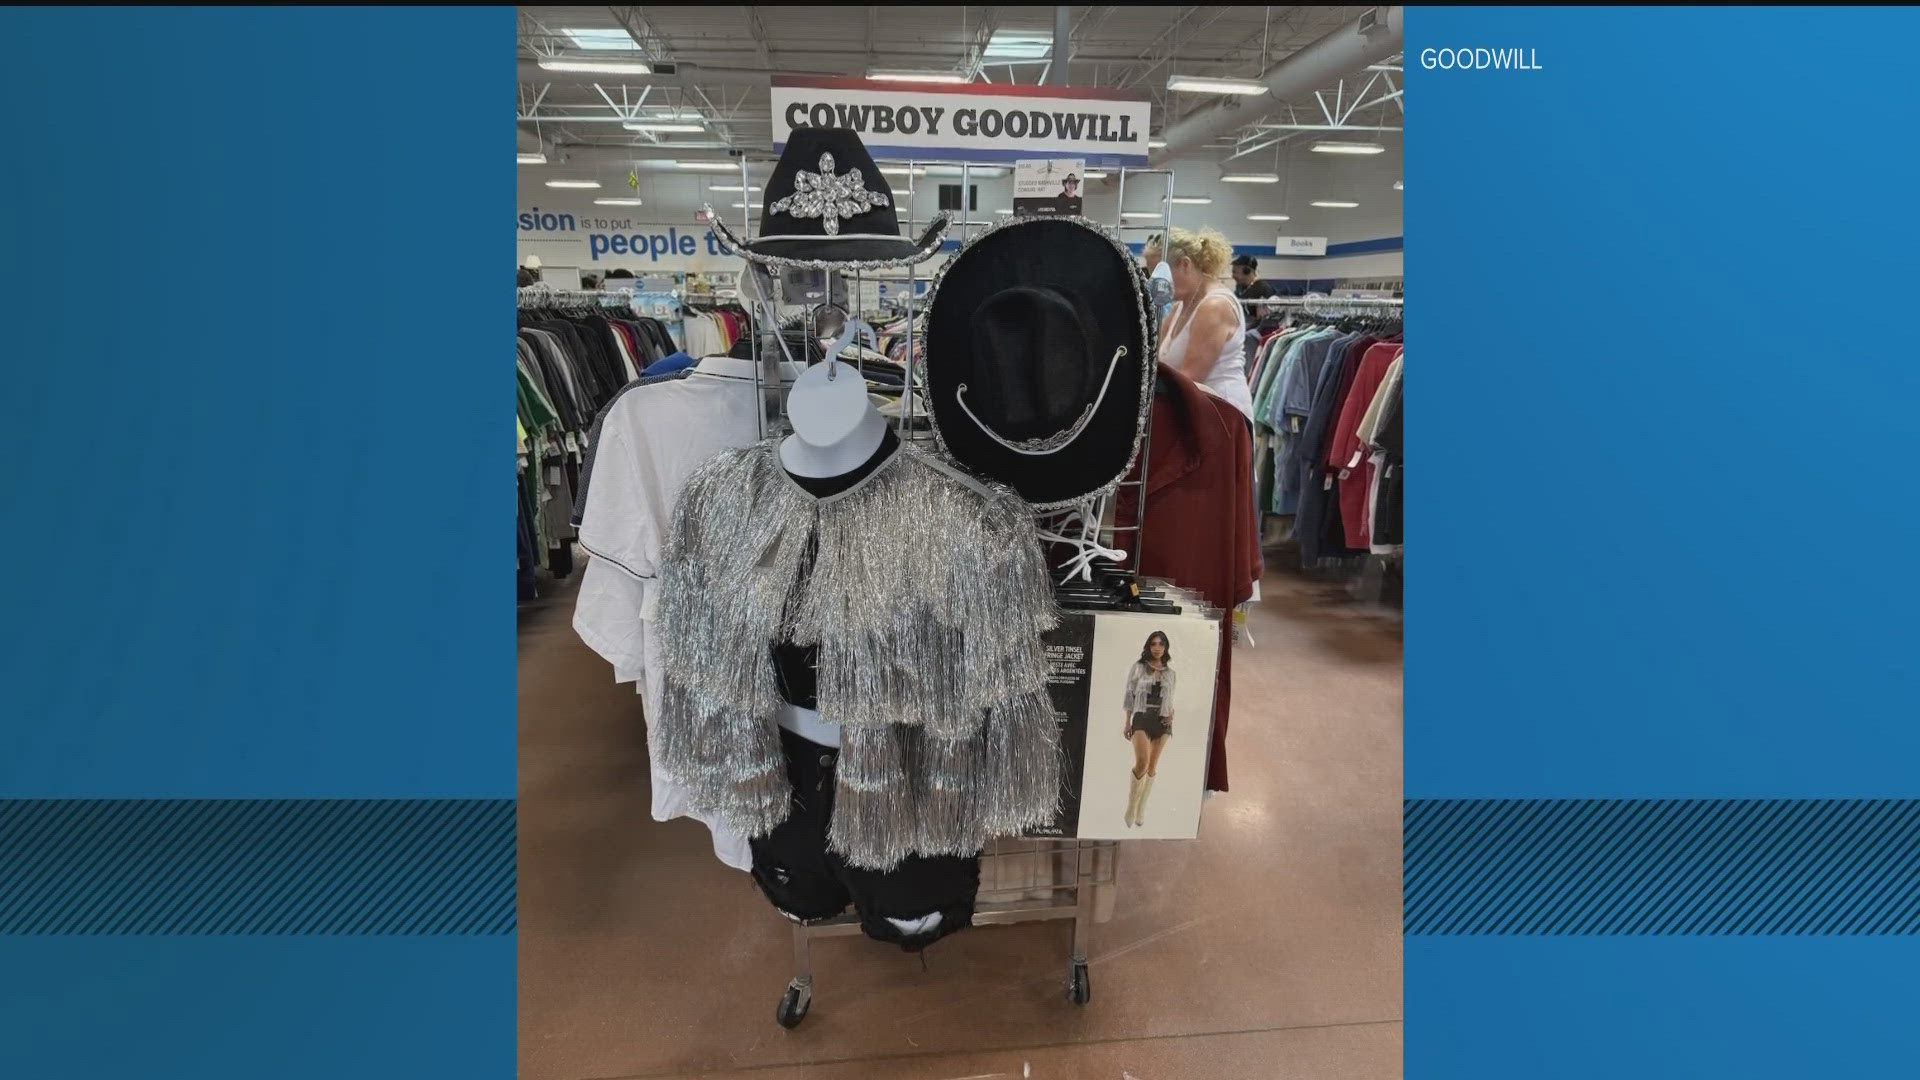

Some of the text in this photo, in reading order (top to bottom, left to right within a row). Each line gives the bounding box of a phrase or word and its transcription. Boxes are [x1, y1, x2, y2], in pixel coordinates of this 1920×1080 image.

[785, 102, 1138, 142] COWBOY GOODWILL
[517, 207, 632, 231] sion is to put
[590, 227, 696, 261] people
[1290, 239, 1313, 247] Books
